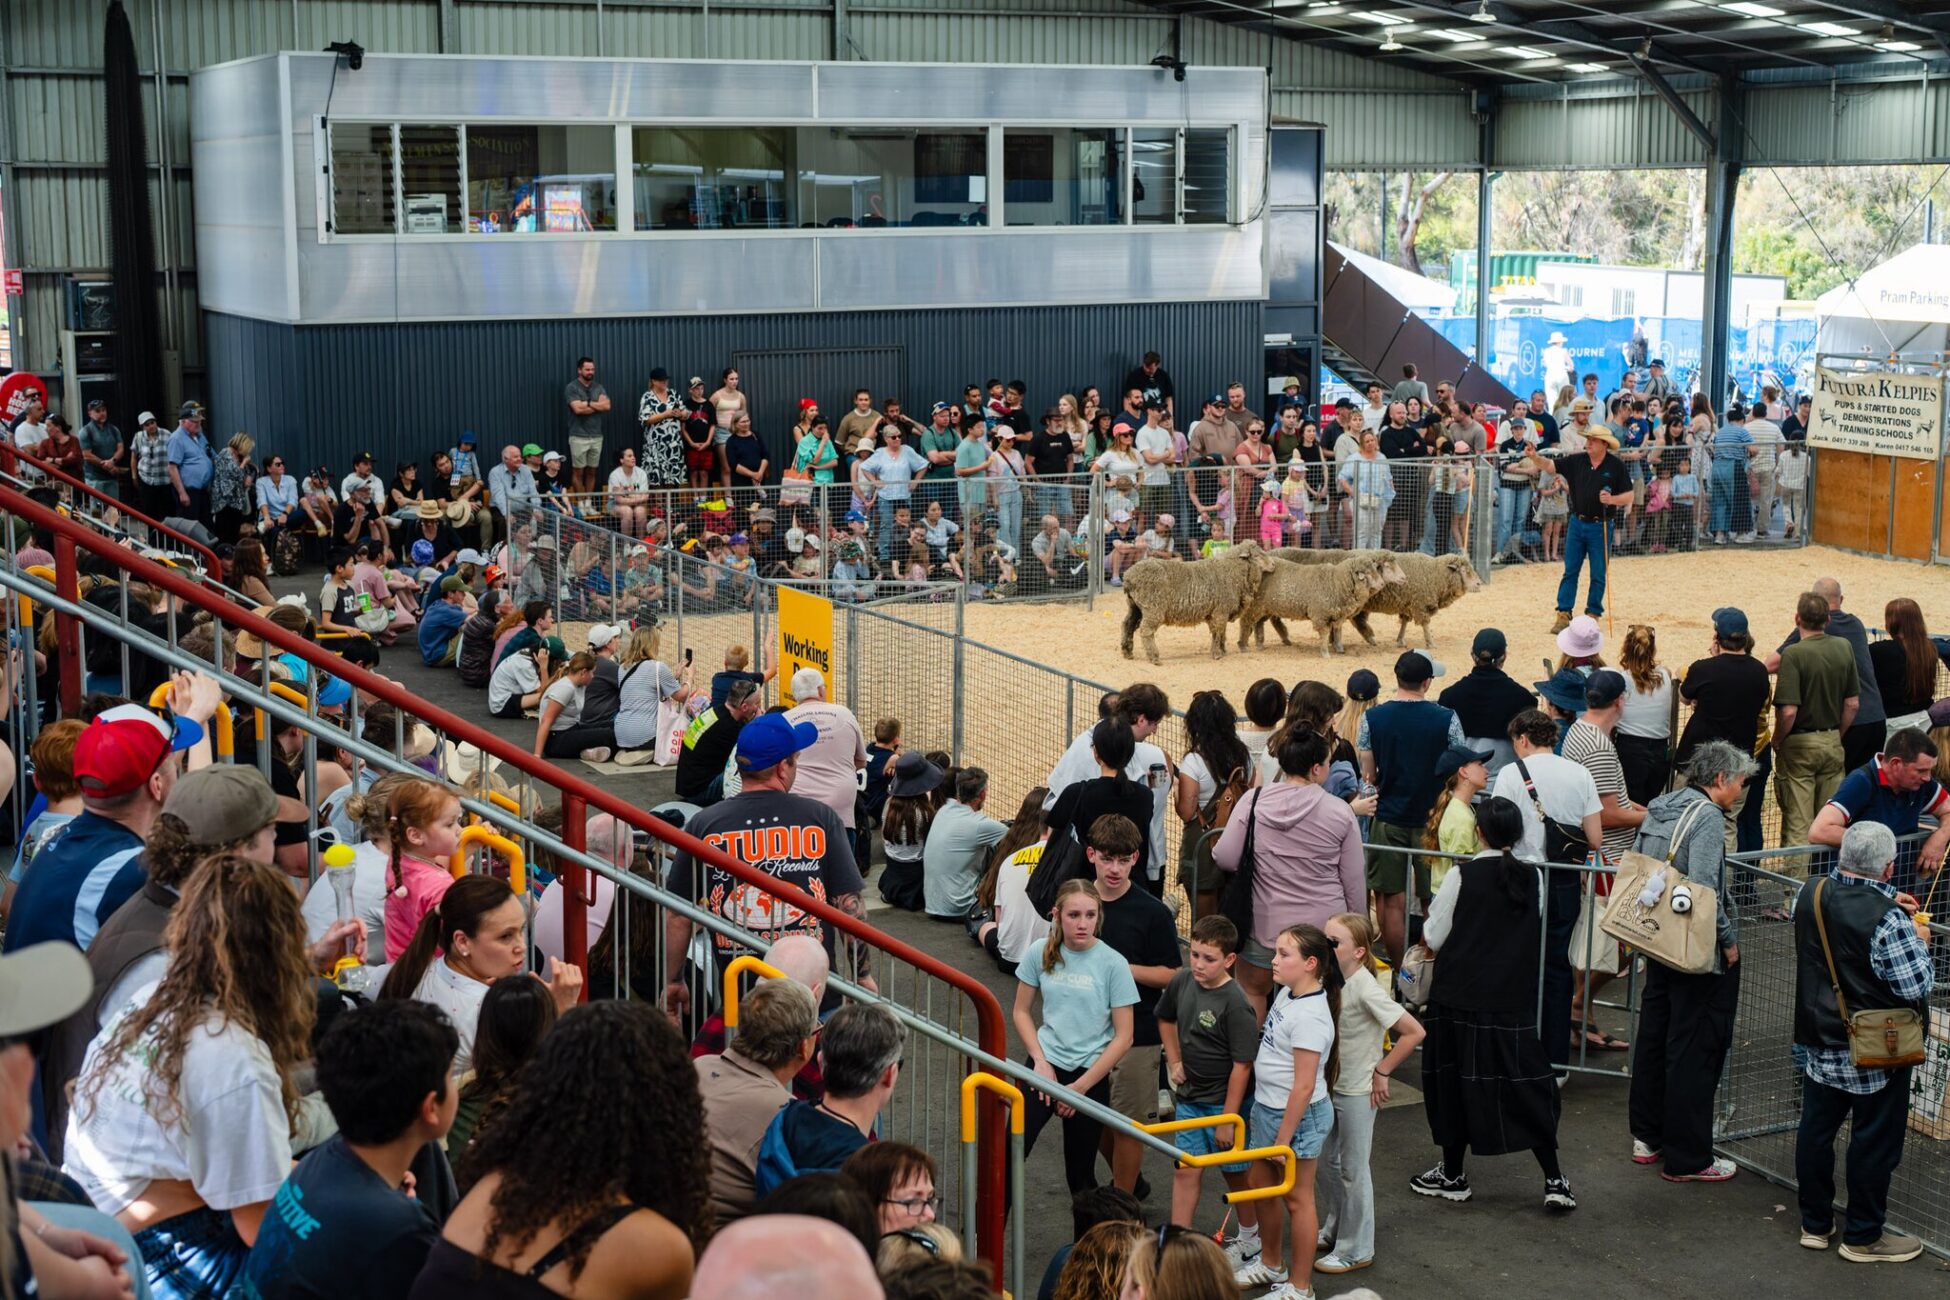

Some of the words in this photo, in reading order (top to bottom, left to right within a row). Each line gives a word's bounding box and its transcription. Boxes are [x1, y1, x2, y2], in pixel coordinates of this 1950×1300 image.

[1880, 289, 1908, 304] Pram
[1910, 291, 1949, 308] Parking
[1819, 374, 1876, 397] FUTURA
[1879, 379, 1937, 402] KELPIES
[1834, 400, 1855, 409] PUPS
[1864, 403, 1897, 414] STARTED
[1899, 406, 1921, 416] DOGS
[1842, 413, 1912, 428] DEMONSTRATIONS
[1838, 424, 1874, 436] TRAINING
[1875, 428, 1914, 440] SCHOOLS
[783, 632, 829, 673] Working
[762, 855, 820, 878] Records
